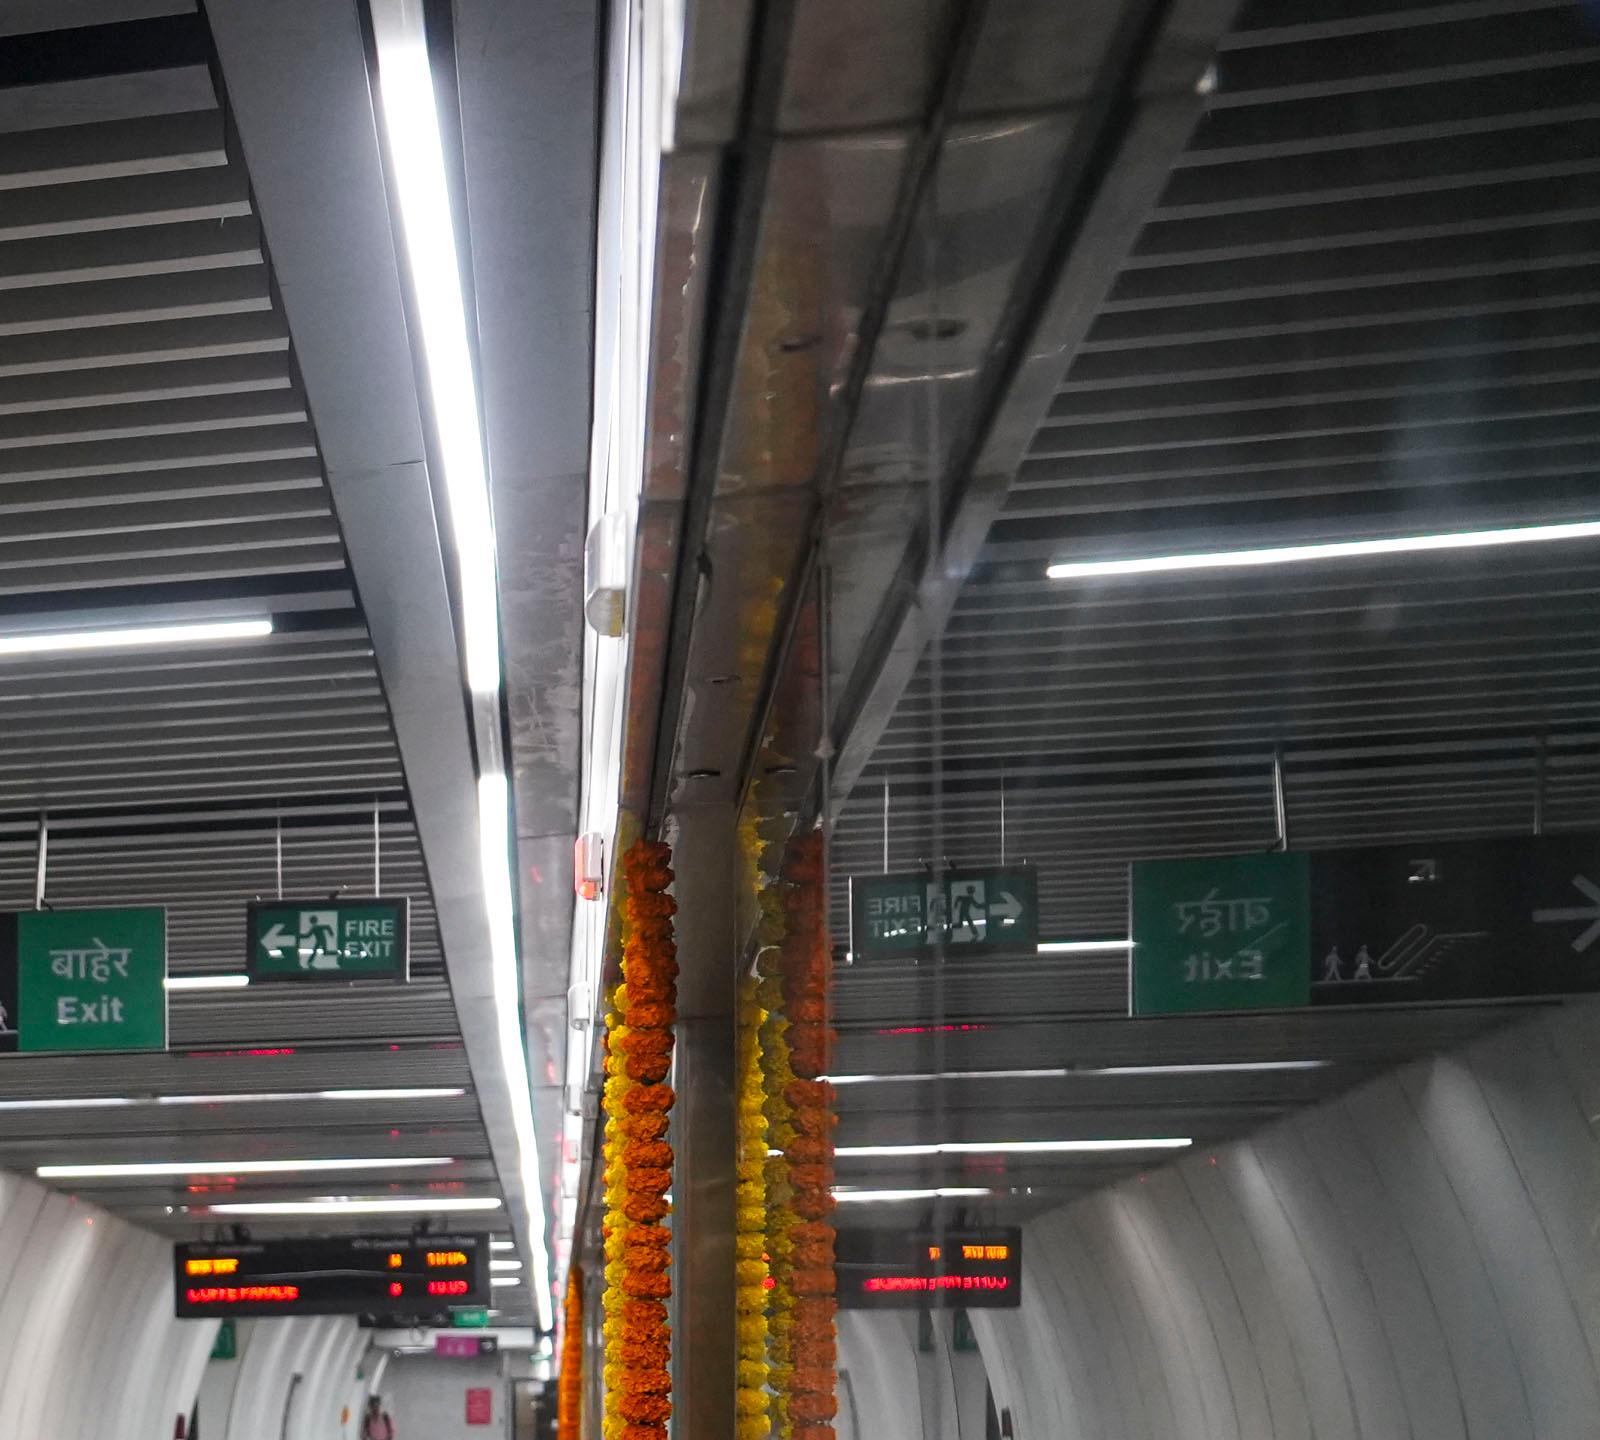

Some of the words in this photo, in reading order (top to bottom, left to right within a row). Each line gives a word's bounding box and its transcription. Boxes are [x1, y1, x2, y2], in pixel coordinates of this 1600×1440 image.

[345, 919, 394, 937] FIRE
[49, 937, 133, 984] बाहेर
[344, 941, 394, 958] EXIT
[57, 994, 124, 1025] Exit
